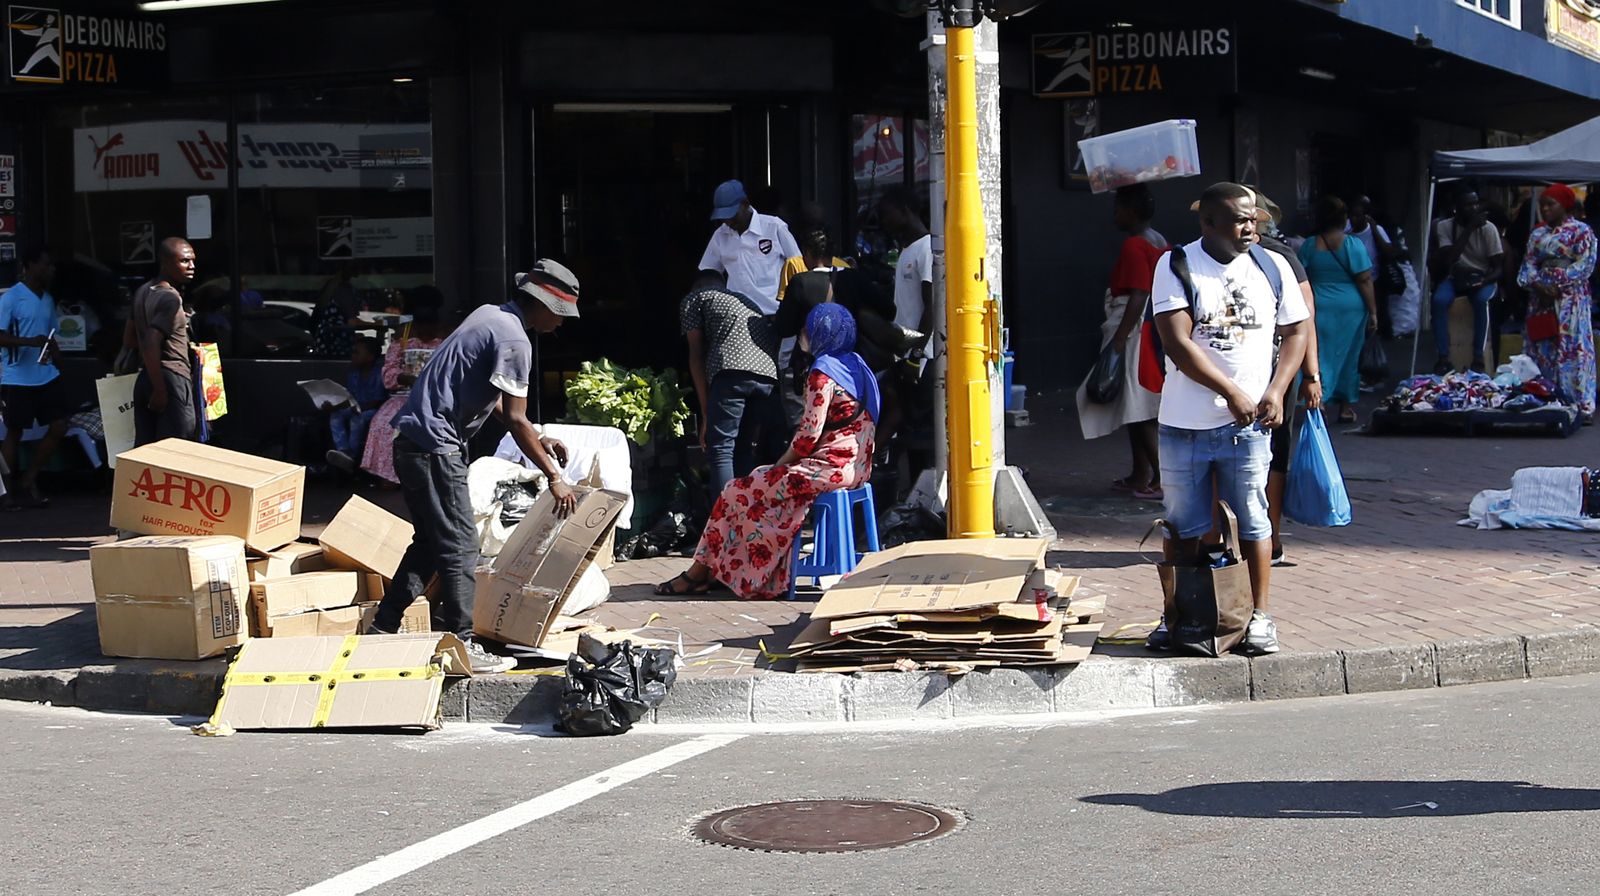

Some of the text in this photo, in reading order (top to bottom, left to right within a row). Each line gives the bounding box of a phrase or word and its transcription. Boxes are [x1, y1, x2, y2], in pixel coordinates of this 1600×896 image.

[64, 14, 166, 51] DEBONAIRS
[1097, 28, 1230, 60] DEBONAIRS
[65, 51, 118, 82] PIZZA
[1097, 63, 1163, 92] PIZZA
[128, 467, 231, 522] AFRO
[142, 514, 163, 528] HAIR
[199, 518, 216, 530] tex
[214, 615, 222, 633] ITEM
[223, 600, 232, 631] COLOUR
